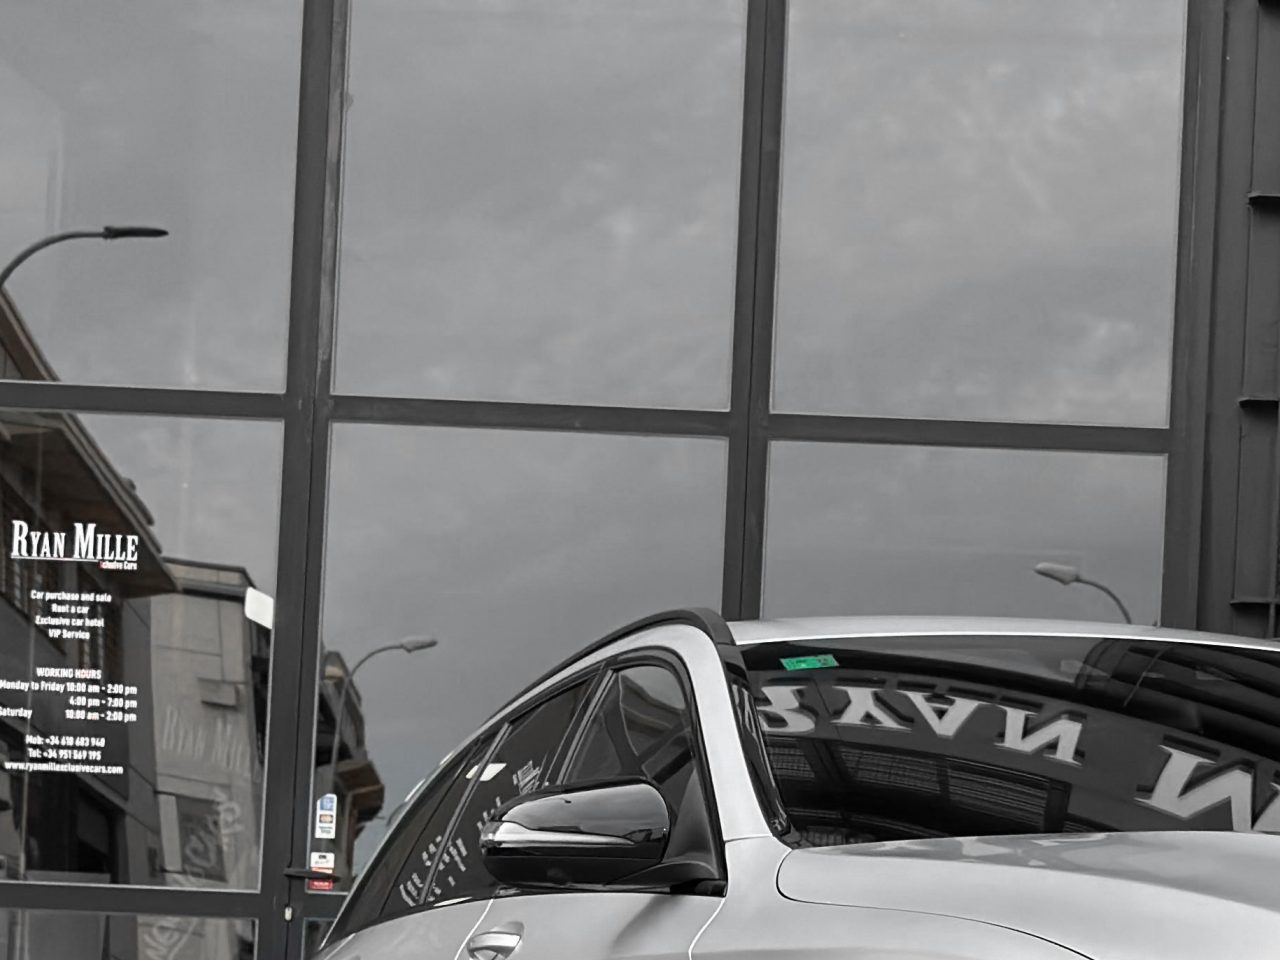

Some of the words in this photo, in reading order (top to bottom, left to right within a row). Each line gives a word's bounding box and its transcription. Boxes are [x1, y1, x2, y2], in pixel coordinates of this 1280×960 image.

[11, 519, 66, 558] RYAN
[73, 523, 139, 562] MILLE
[30, 590, 44, 599] Car
[45, 591, 80, 601] purchase
[80, 593, 95, 602] and
[95, 593, 112, 602] sale
[76, 606, 90, 614] car
[35, 615, 71, 626] Exclusive
[71, 618, 84, 626] car
[48, 628, 61, 638] VIP
[62, 629, 91, 639] Service
[36, 667, 74, 678] WORKING
[75, 669, 102, 679] HOURS
[30, 681, 40, 690] to
[40, 680, 65, 693] Friday
[66, 682, 86, 693] 10:00
[87, 684, 100, 693] am
[107, 683, 123, 694] 2:00
[124, 686, 138, 696] pm
[87, 698, 100, 708] pm
[124, 699, 138, 710] pm
[87, 711, 100, 720] am
[106, 710, 123, 721] 2:00
[124, 713, 137, 723] pm
